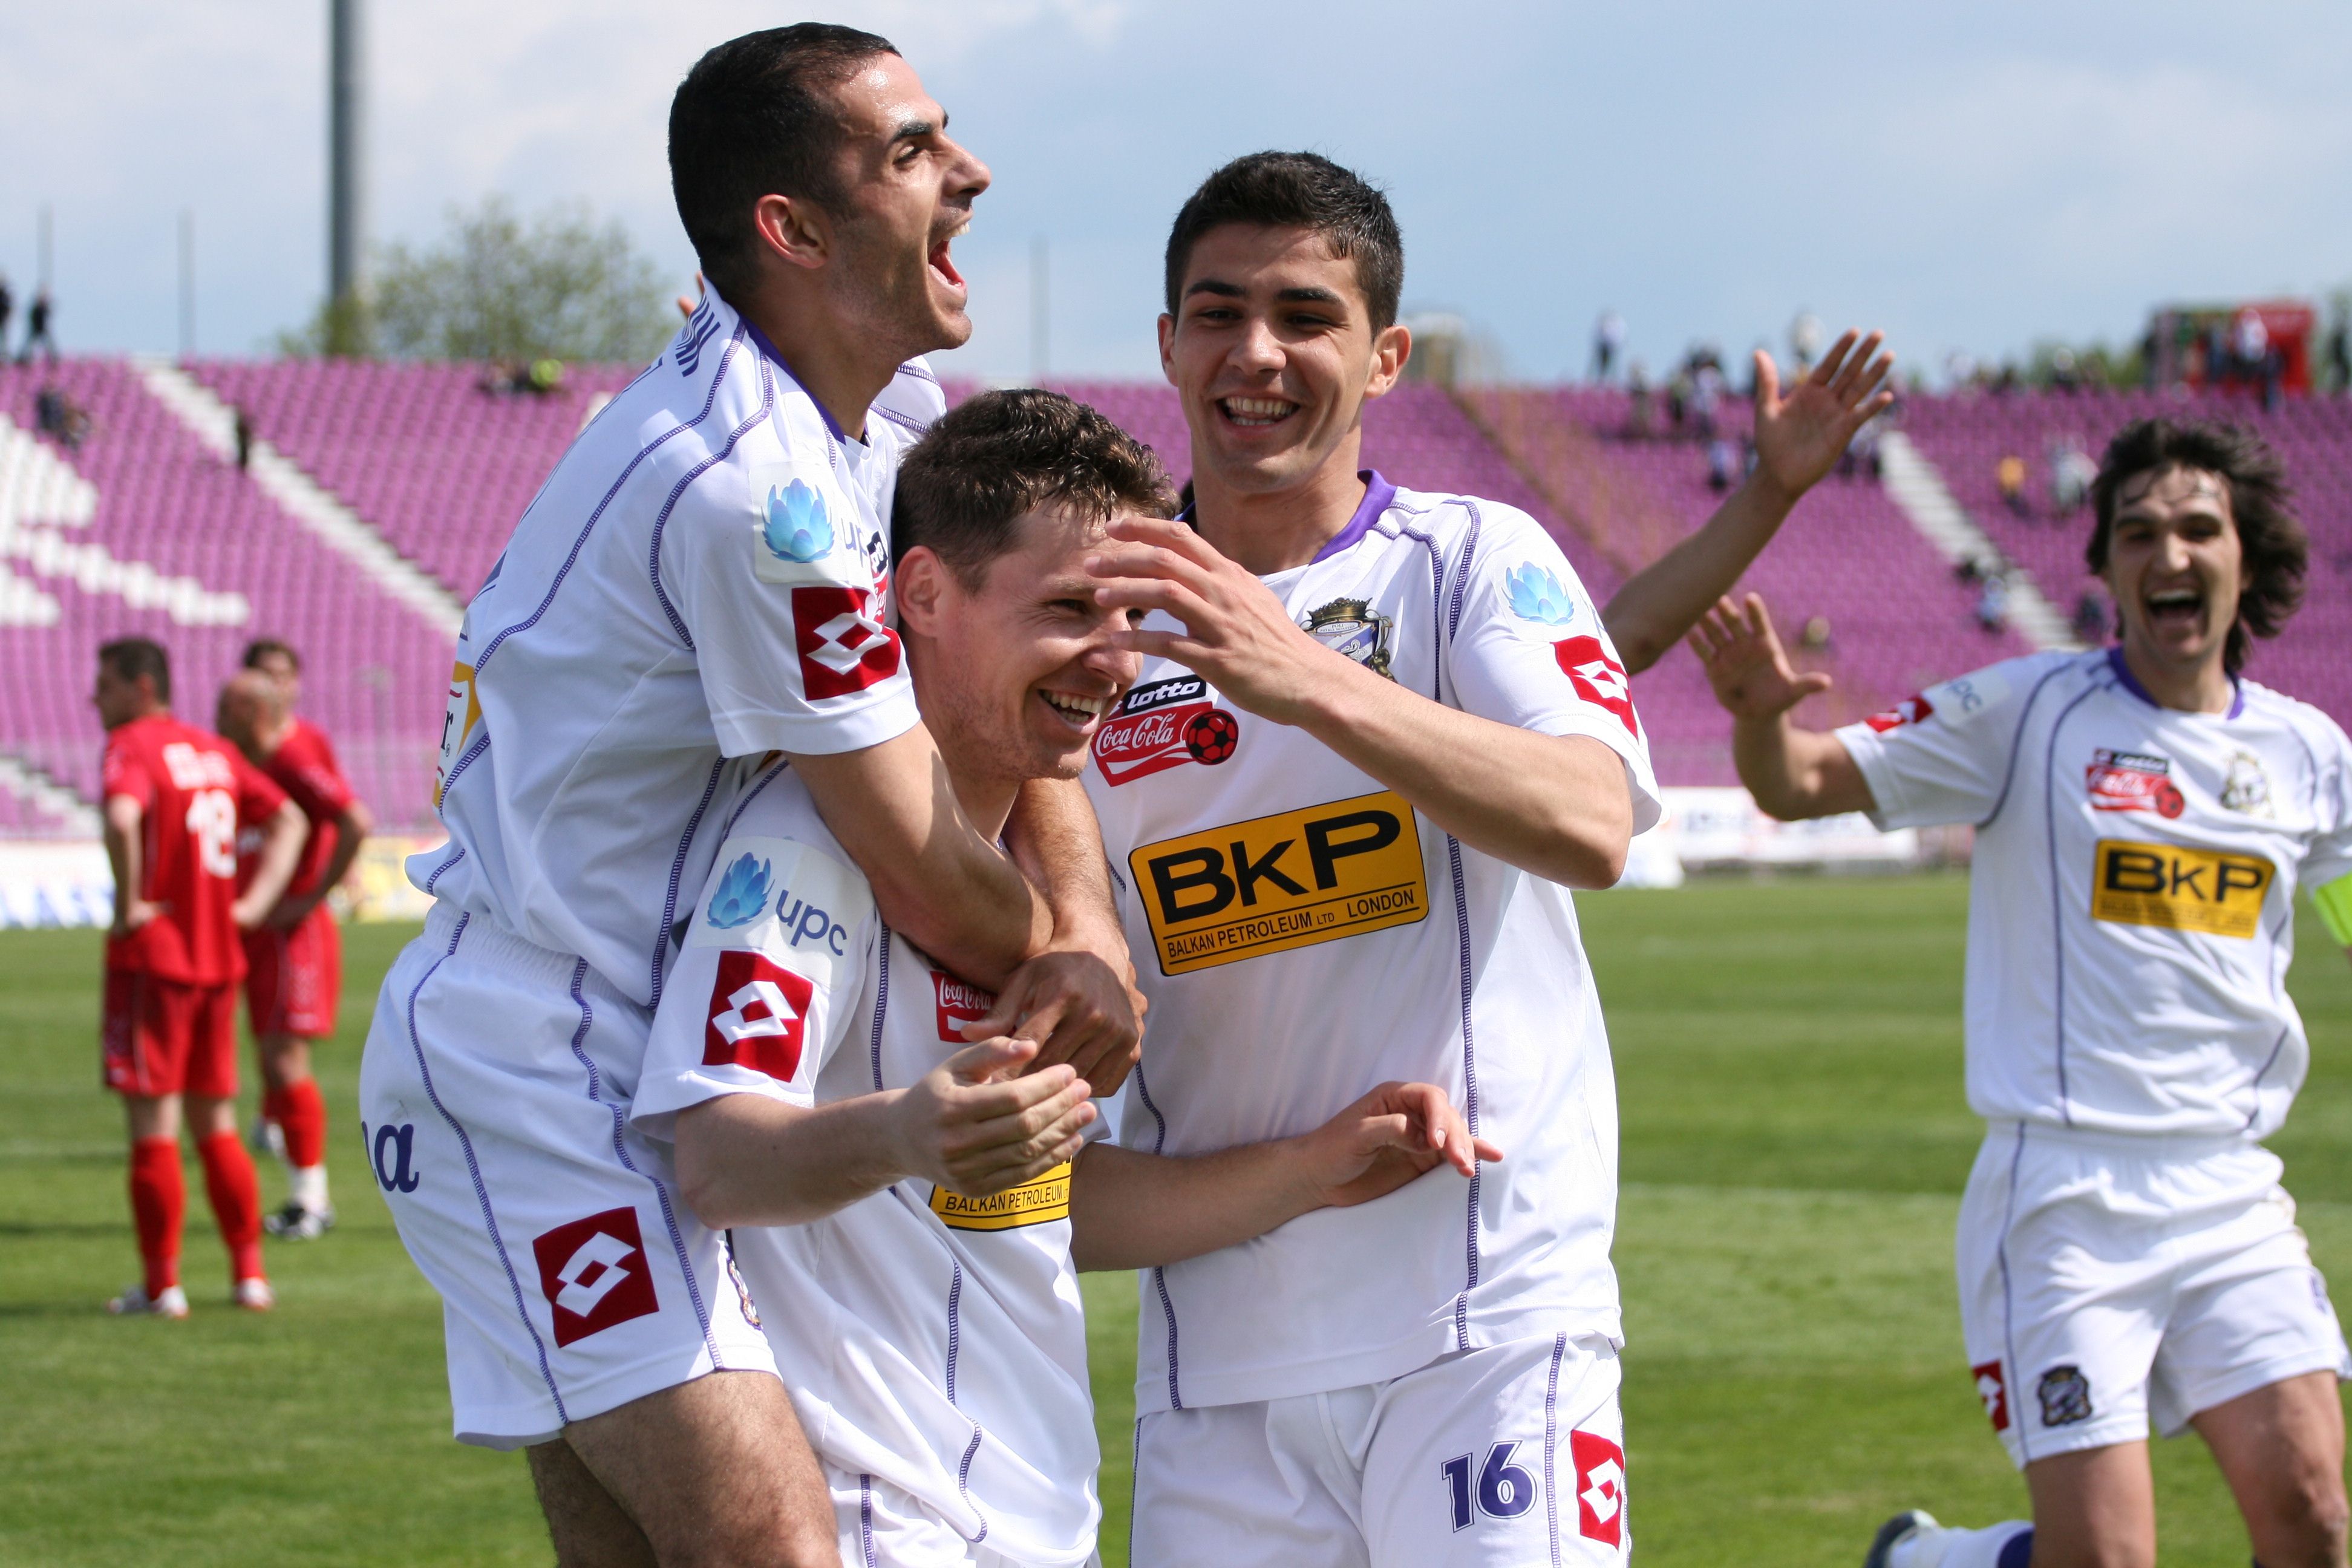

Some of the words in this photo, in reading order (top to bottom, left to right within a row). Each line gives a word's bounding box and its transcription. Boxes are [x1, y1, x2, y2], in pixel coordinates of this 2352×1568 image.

[1096, 725, 1132, 757] Coca
[1132, 712, 1177, 749] Cola
[775, 889, 847, 956] upc
[1168, 933, 1215, 958] BALKAN
[1218, 912, 1313, 947] PETROLEUM
[1316, 912, 1335, 926] LTD
[1347, 889, 1414, 918] LONDON
[945, 1194, 1006, 1212] BALKAN
[1008, 1184, 1063, 1209] PETROLEUM
[1441, 1440, 1538, 1533] 16
